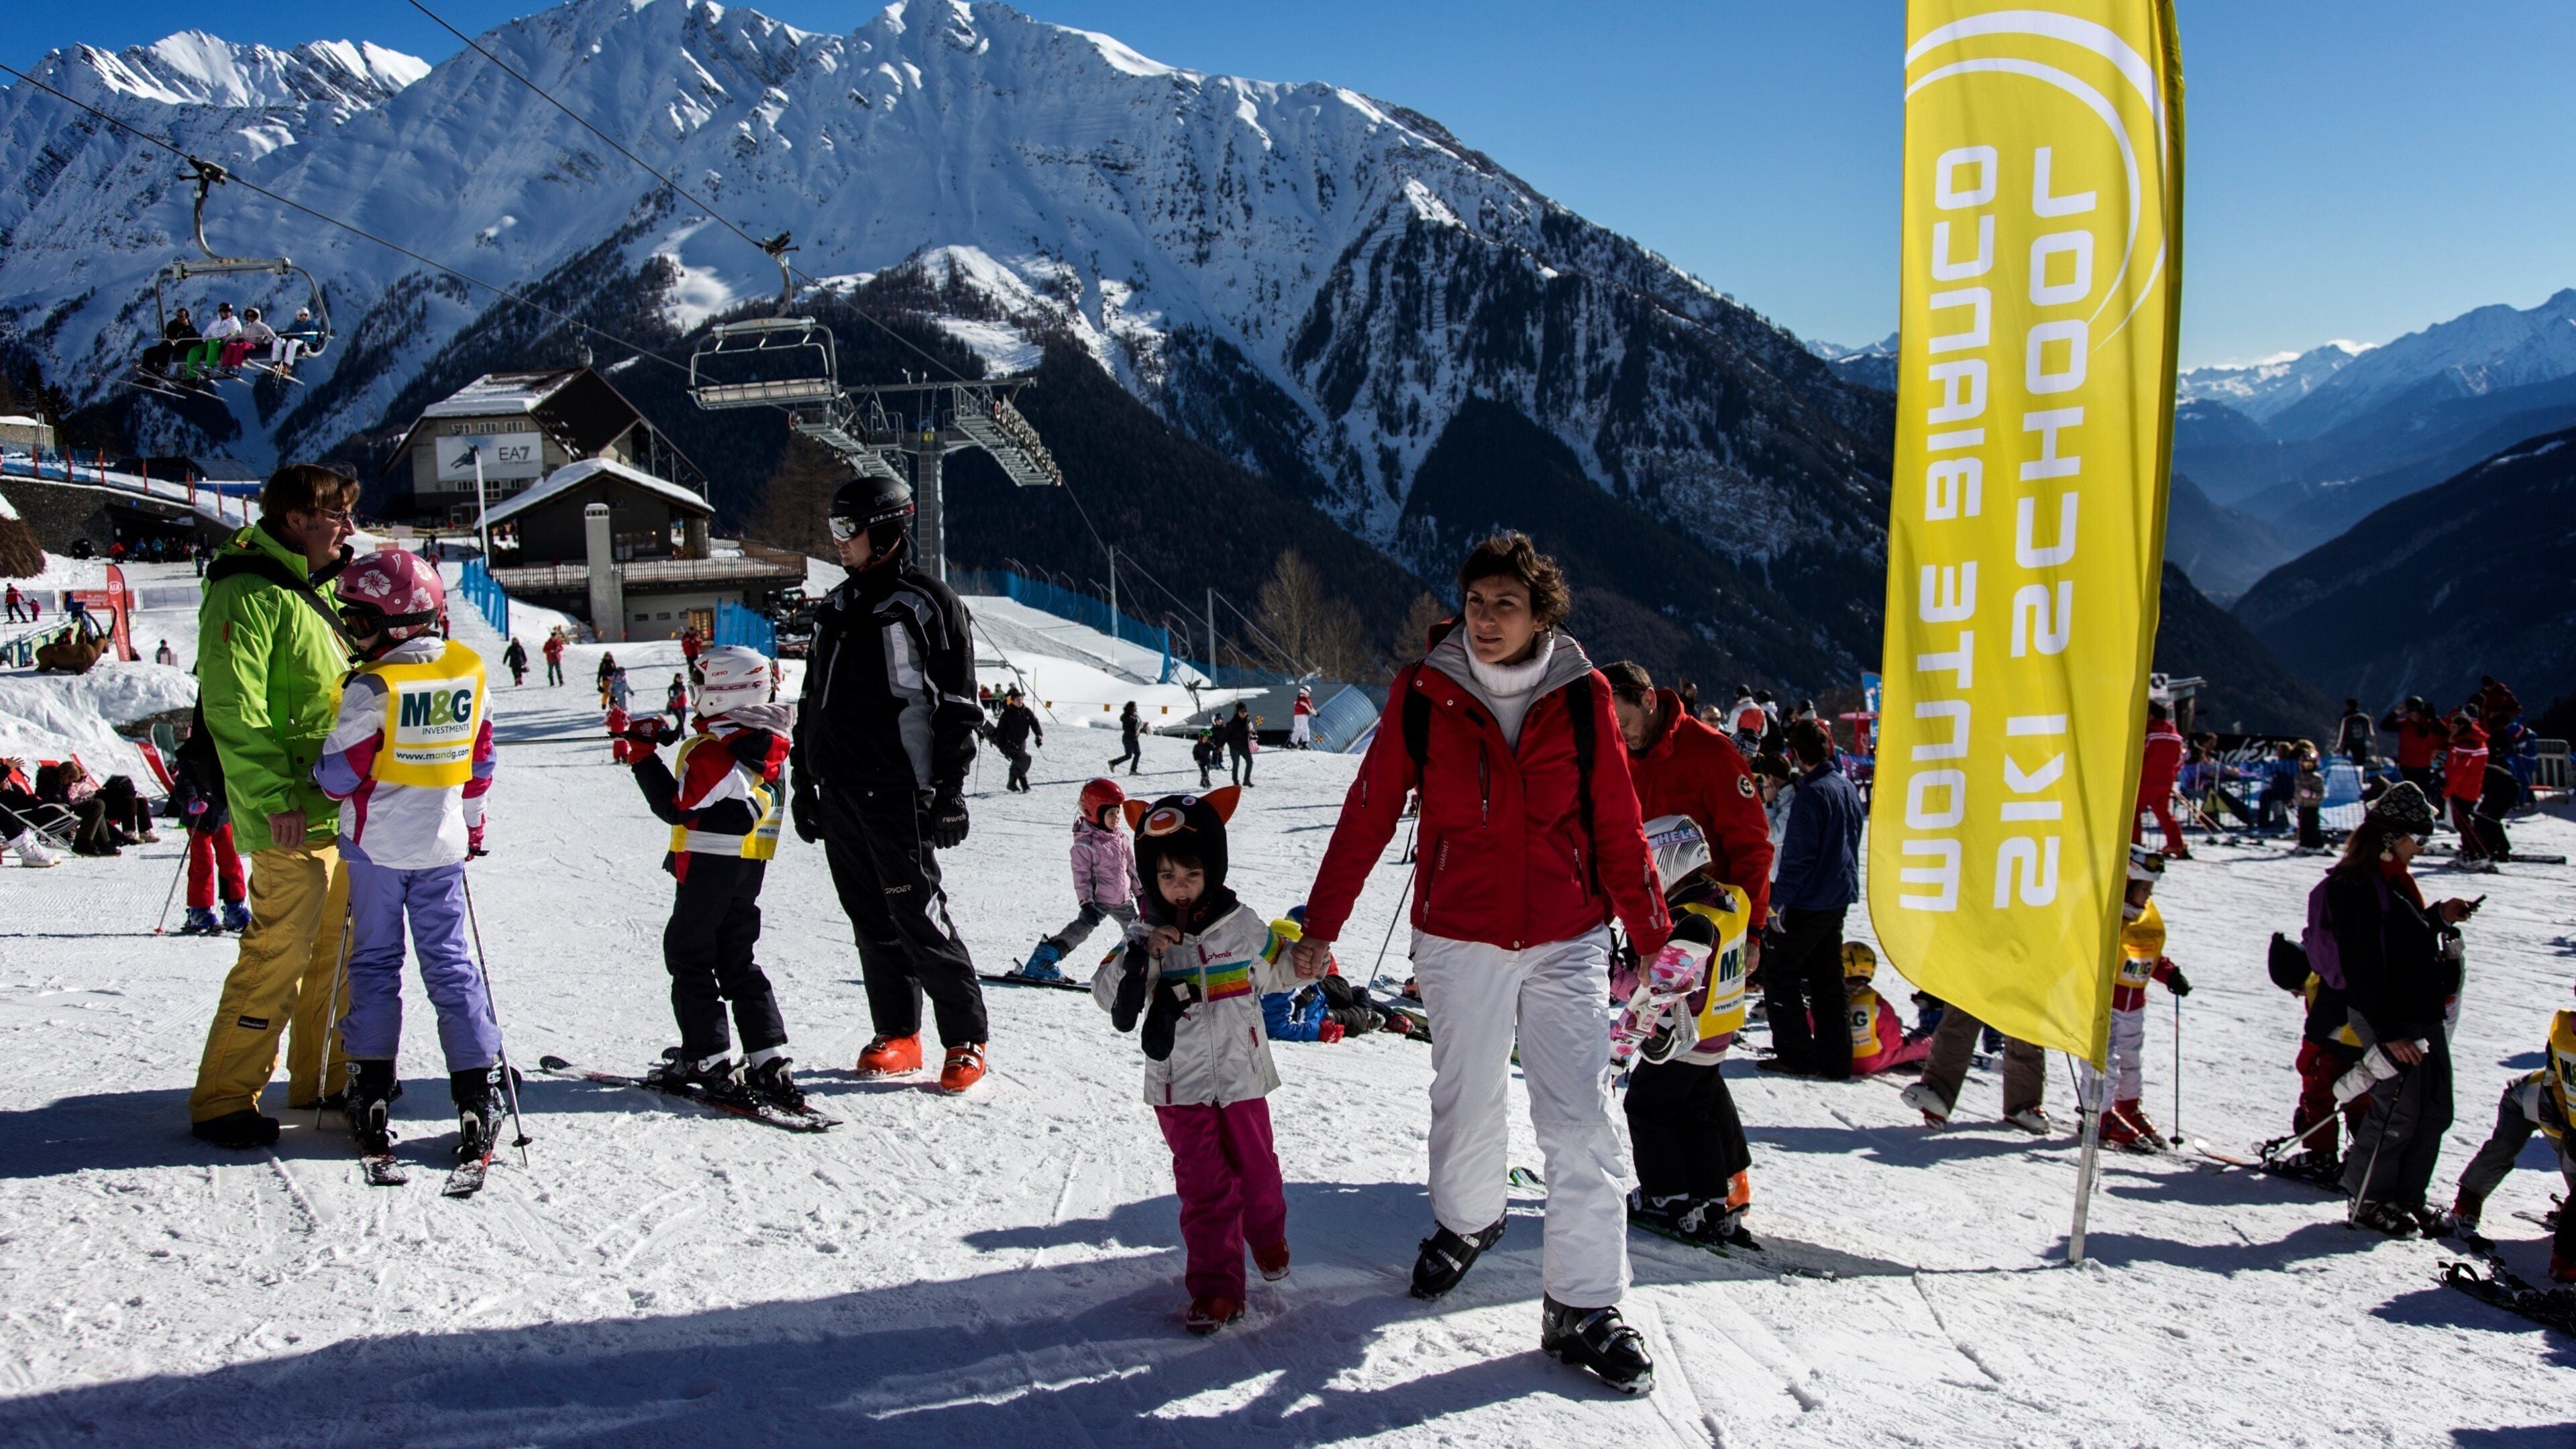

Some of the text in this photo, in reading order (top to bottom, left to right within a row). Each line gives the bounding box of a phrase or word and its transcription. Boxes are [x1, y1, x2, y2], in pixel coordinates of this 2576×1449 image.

[499, 446, 530, 460] EA7
[400, 689, 472, 727] M&G
[422, 723, 470, 735] INVESTMENTS
[942, 812, 966, 823] reusch
[885, 884, 912, 894] SPYDER
[1208, 950, 1232, 961] phenix
[1643, 1208, 1669, 1216] HEAD
